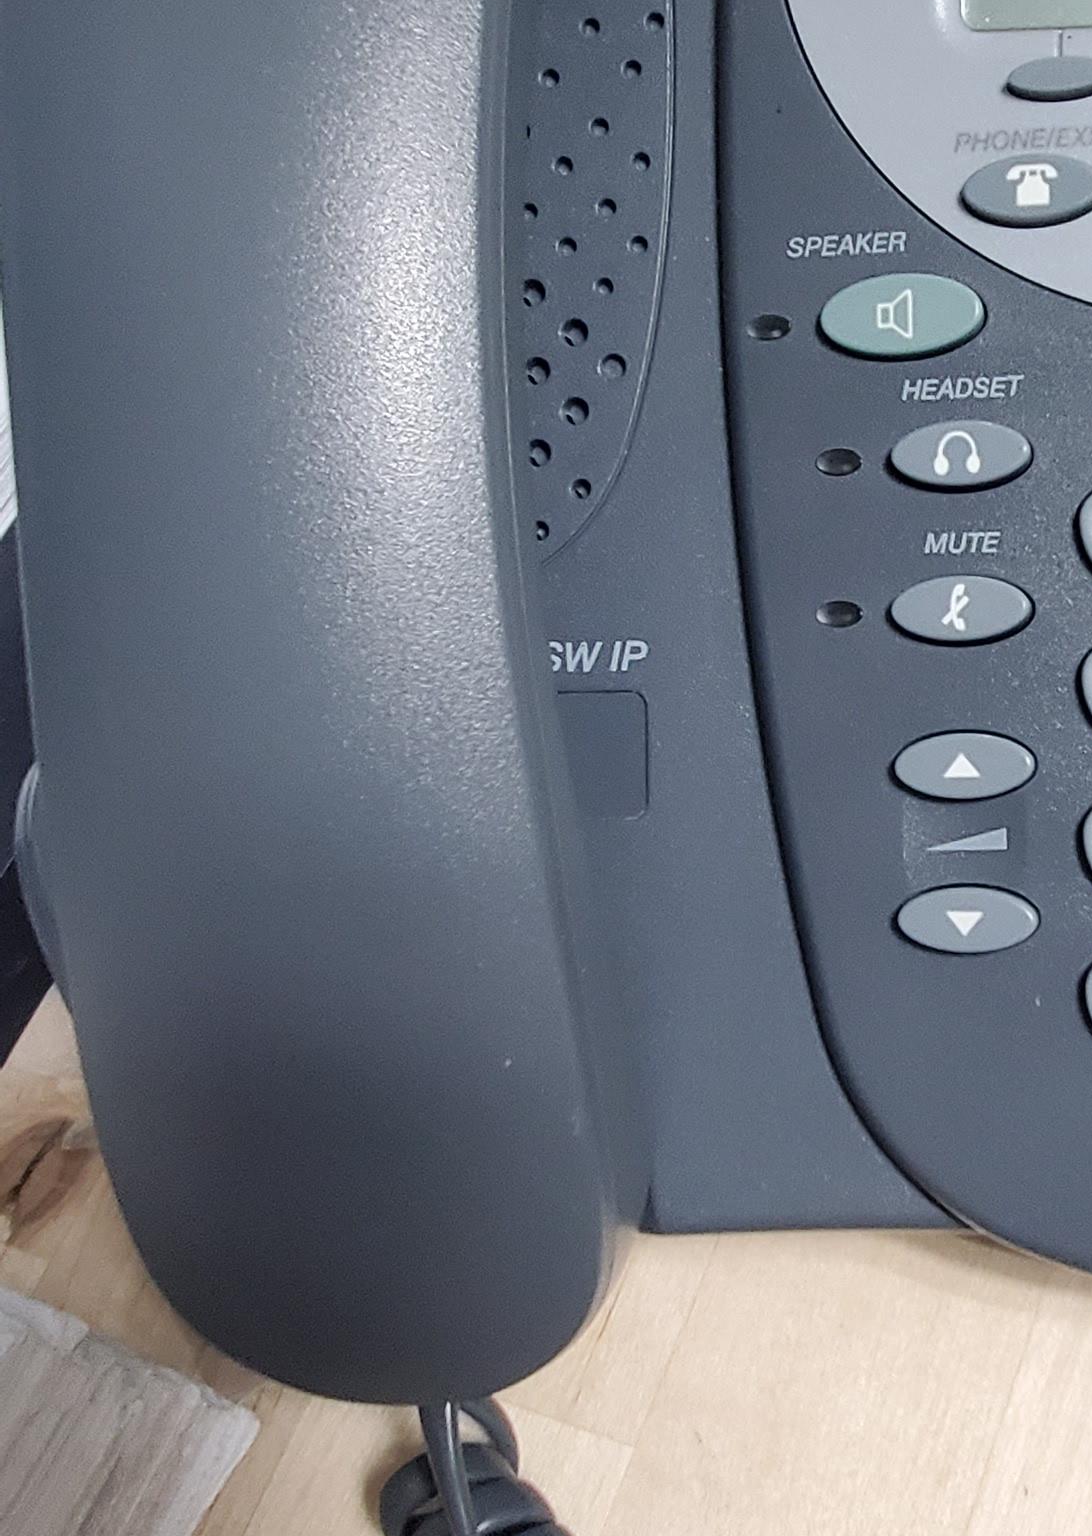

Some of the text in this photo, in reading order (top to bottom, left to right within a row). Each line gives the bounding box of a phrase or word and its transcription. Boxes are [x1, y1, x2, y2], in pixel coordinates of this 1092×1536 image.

[786, 232, 908, 259] SPEAKER
[901, 374, 1025, 401] HEADSET
[924, 531, 1001, 555] MUTE
[609, 639, 649, 672] IP
